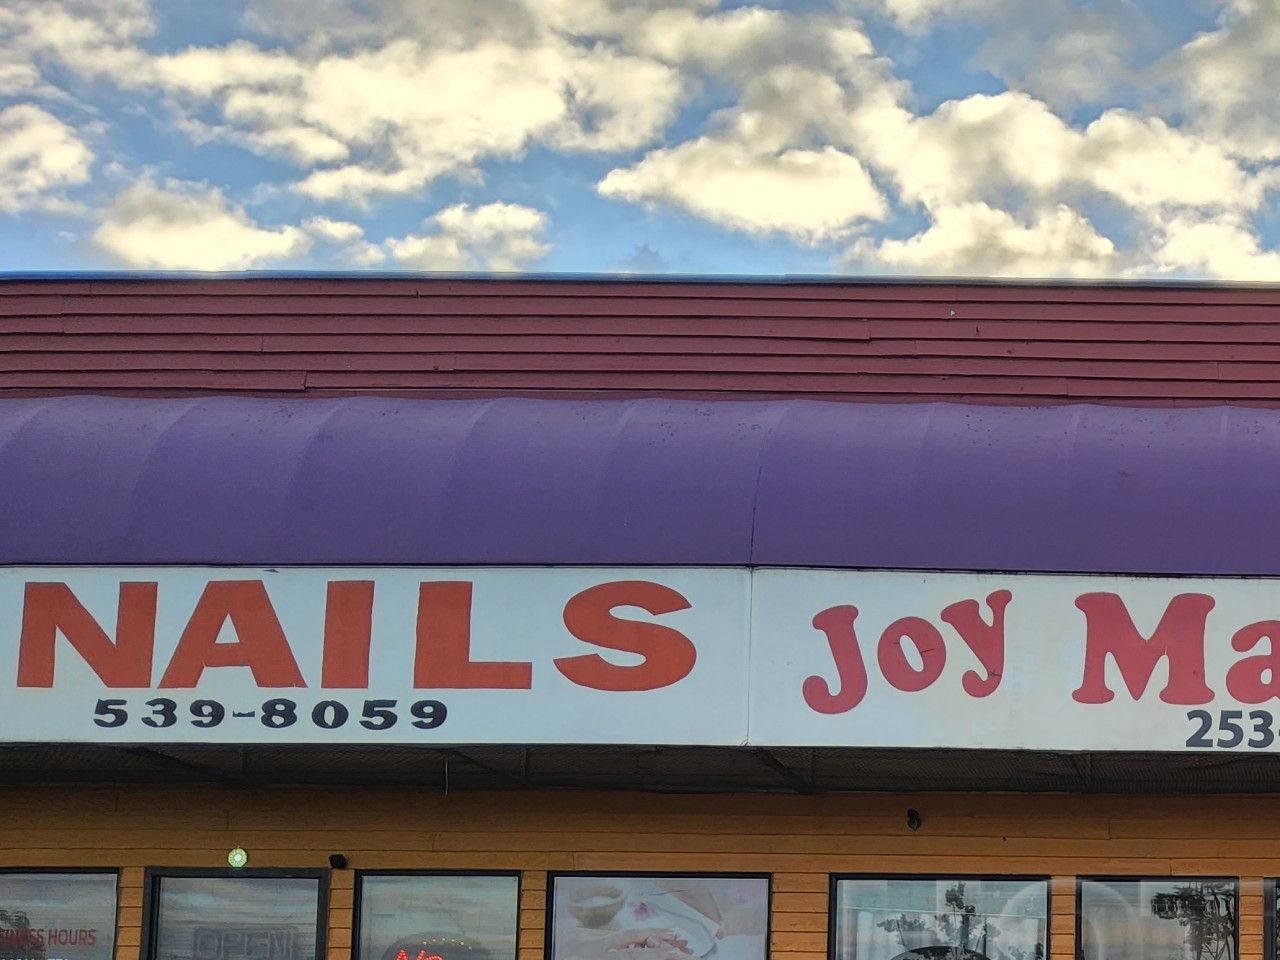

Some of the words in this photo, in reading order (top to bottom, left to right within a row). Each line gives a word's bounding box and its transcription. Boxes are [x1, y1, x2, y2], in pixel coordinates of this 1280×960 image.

[16, 579, 698, 692] NAILS
[801, 588, 1012, 716] Joy
[93, 697, 449, 731] 539-8059
[48, 928, 97, 946] HOURS
